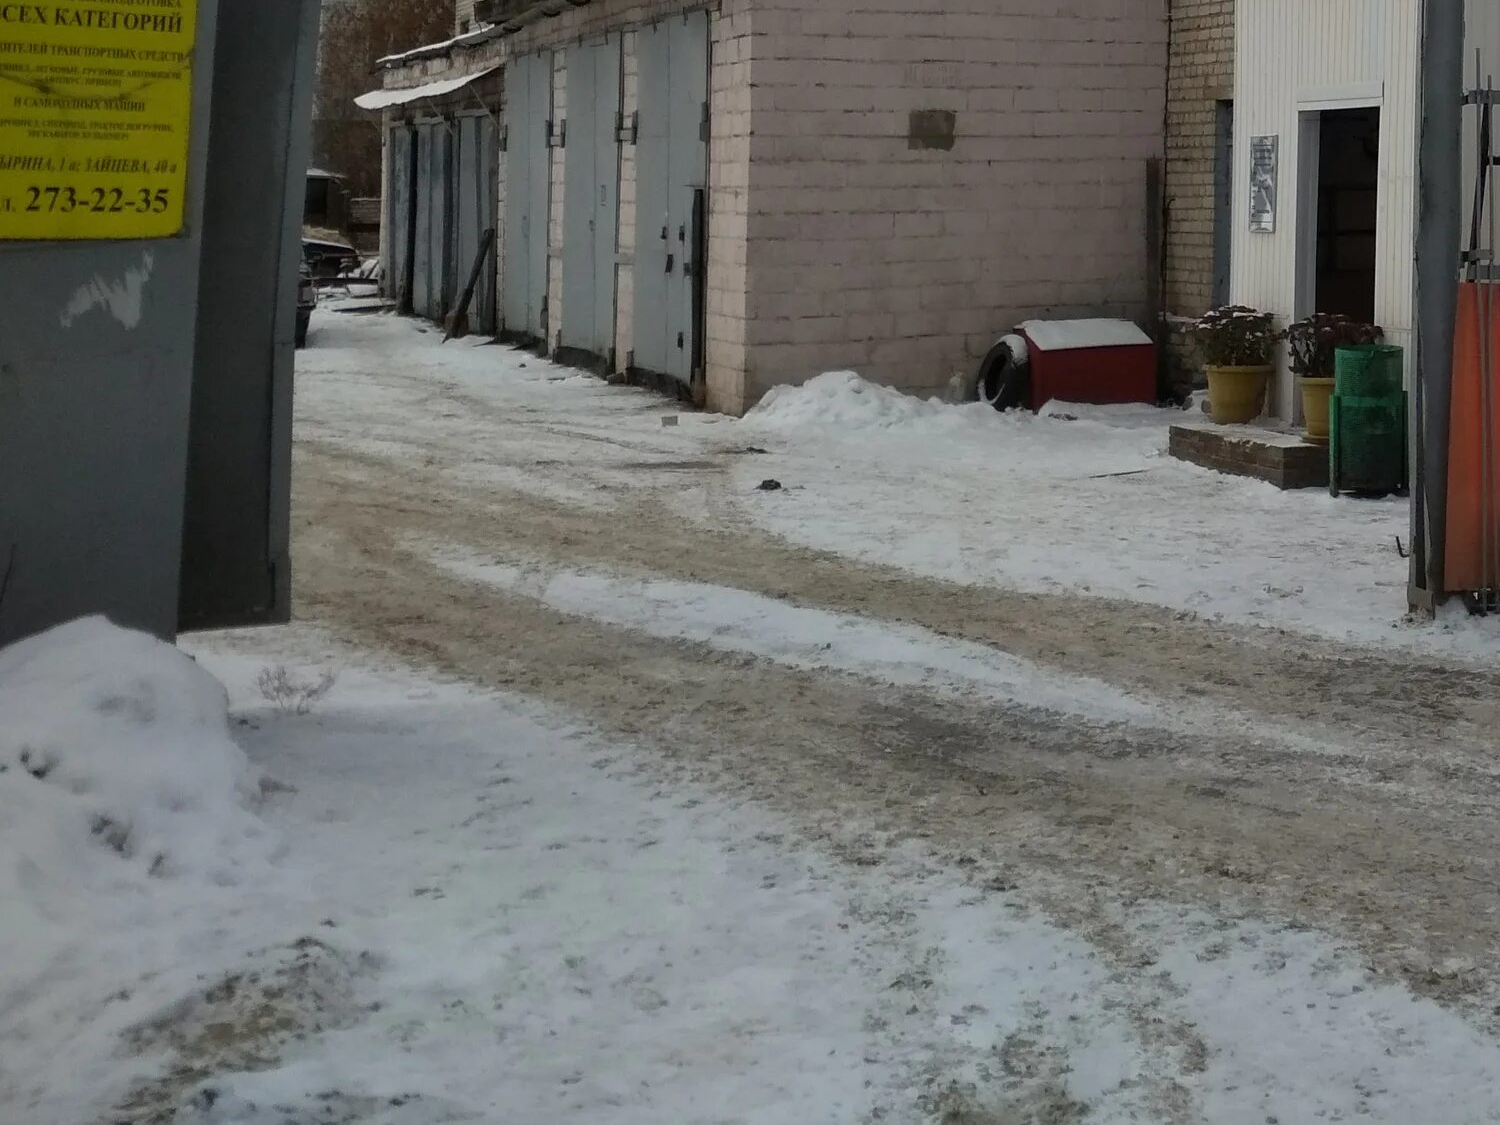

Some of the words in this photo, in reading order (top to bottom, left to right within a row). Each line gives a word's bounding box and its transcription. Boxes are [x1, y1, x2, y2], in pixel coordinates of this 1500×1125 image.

[0, 4, 49, 25] СЕХ
[55, 6, 182, 33] КАТЕГОРИЙ
[26, 186, 169, 213] 273-22-35
